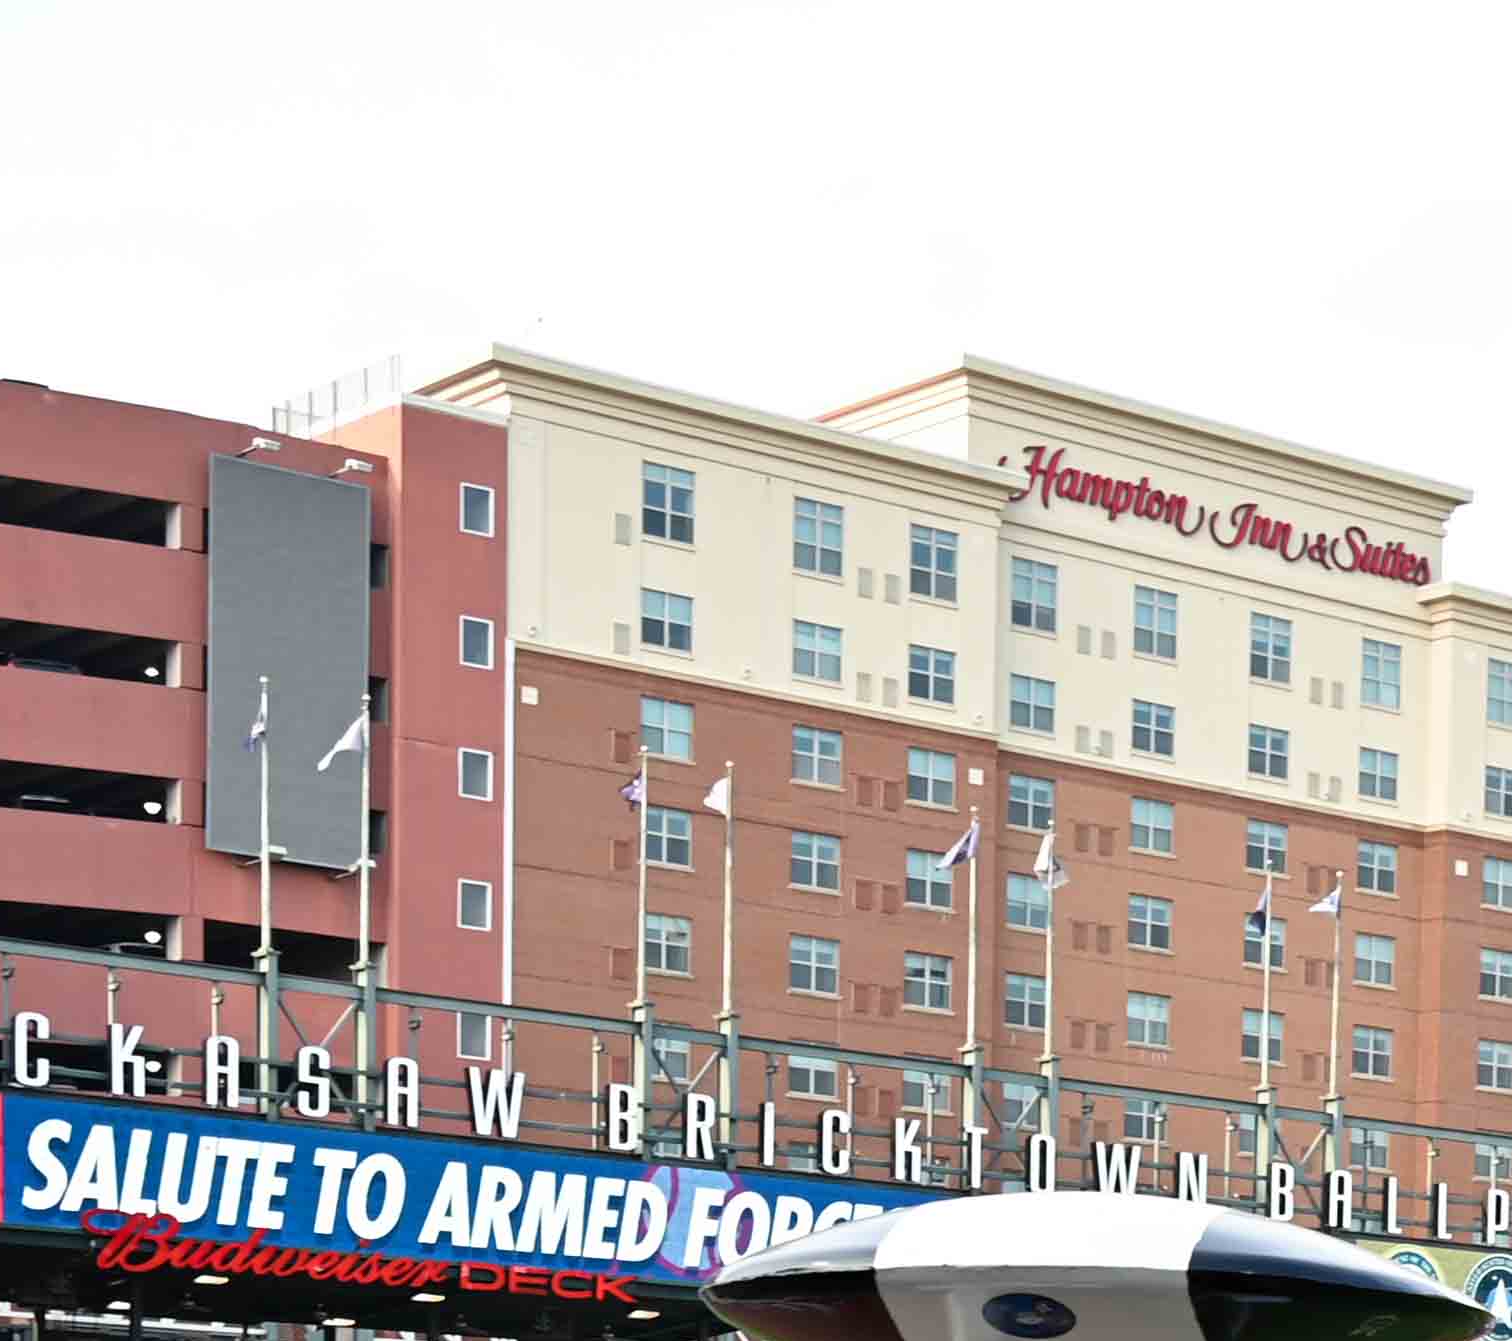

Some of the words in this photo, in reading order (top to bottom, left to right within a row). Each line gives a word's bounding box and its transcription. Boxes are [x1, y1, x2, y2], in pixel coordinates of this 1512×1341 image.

[999, 445, 1204, 536] Hampton
[1209, 502, 1309, 562] Inn
[1307, 533, 1333, 570] &
[1330, 525, 1432, 586] Suites
[22, 1118, 296, 1229] SALUTE
[313, 1147, 406, 1241] TO
[418, 1161, 668, 1262] ARMED
[683, 1186, 885, 1267] FOR
[608, 1082, 1209, 1204] BRICKTOWN
[81, 1208, 448, 1290] Budweiser
[458, 1262, 638, 1303] DECK
